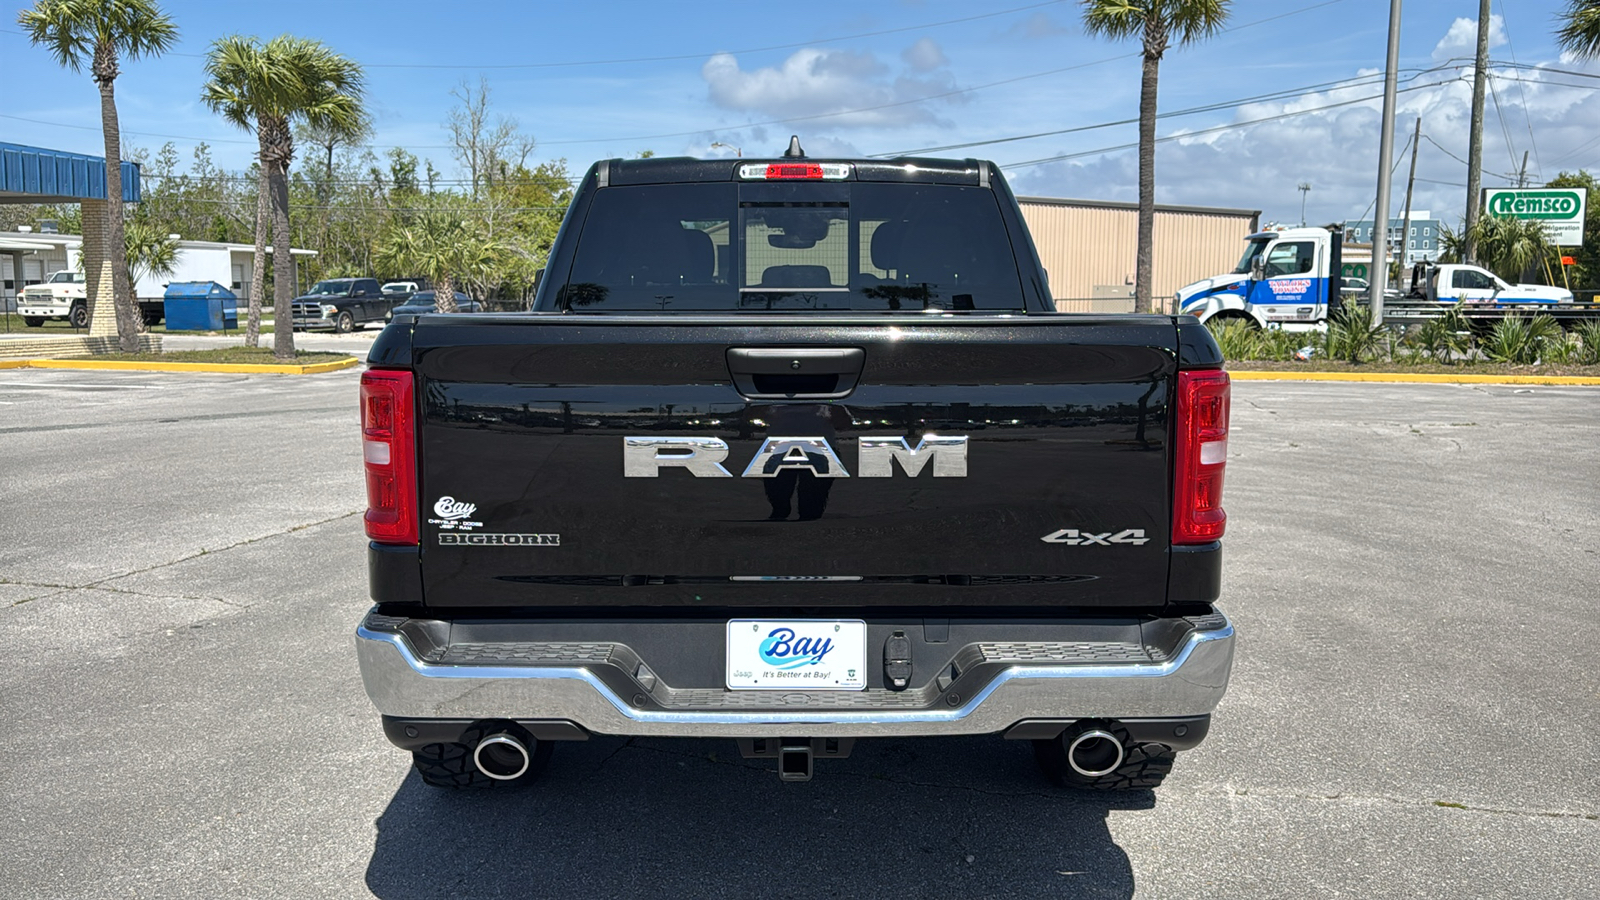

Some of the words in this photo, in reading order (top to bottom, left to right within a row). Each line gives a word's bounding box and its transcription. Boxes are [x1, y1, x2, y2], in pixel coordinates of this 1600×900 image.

[1500, 192, 1571, 212] Remsco
[1272, 286, 1307, 294] TOWING
[624, 436, 969, 478] RAM
[434, 496, 477, 519] Bay
[438, 533, 560, 546] BIGHORN
[1040, 529, 1151, 545] 4x4
[764, 627, 835, 666] Bay
[813, 671, 832, 679] Bay!
